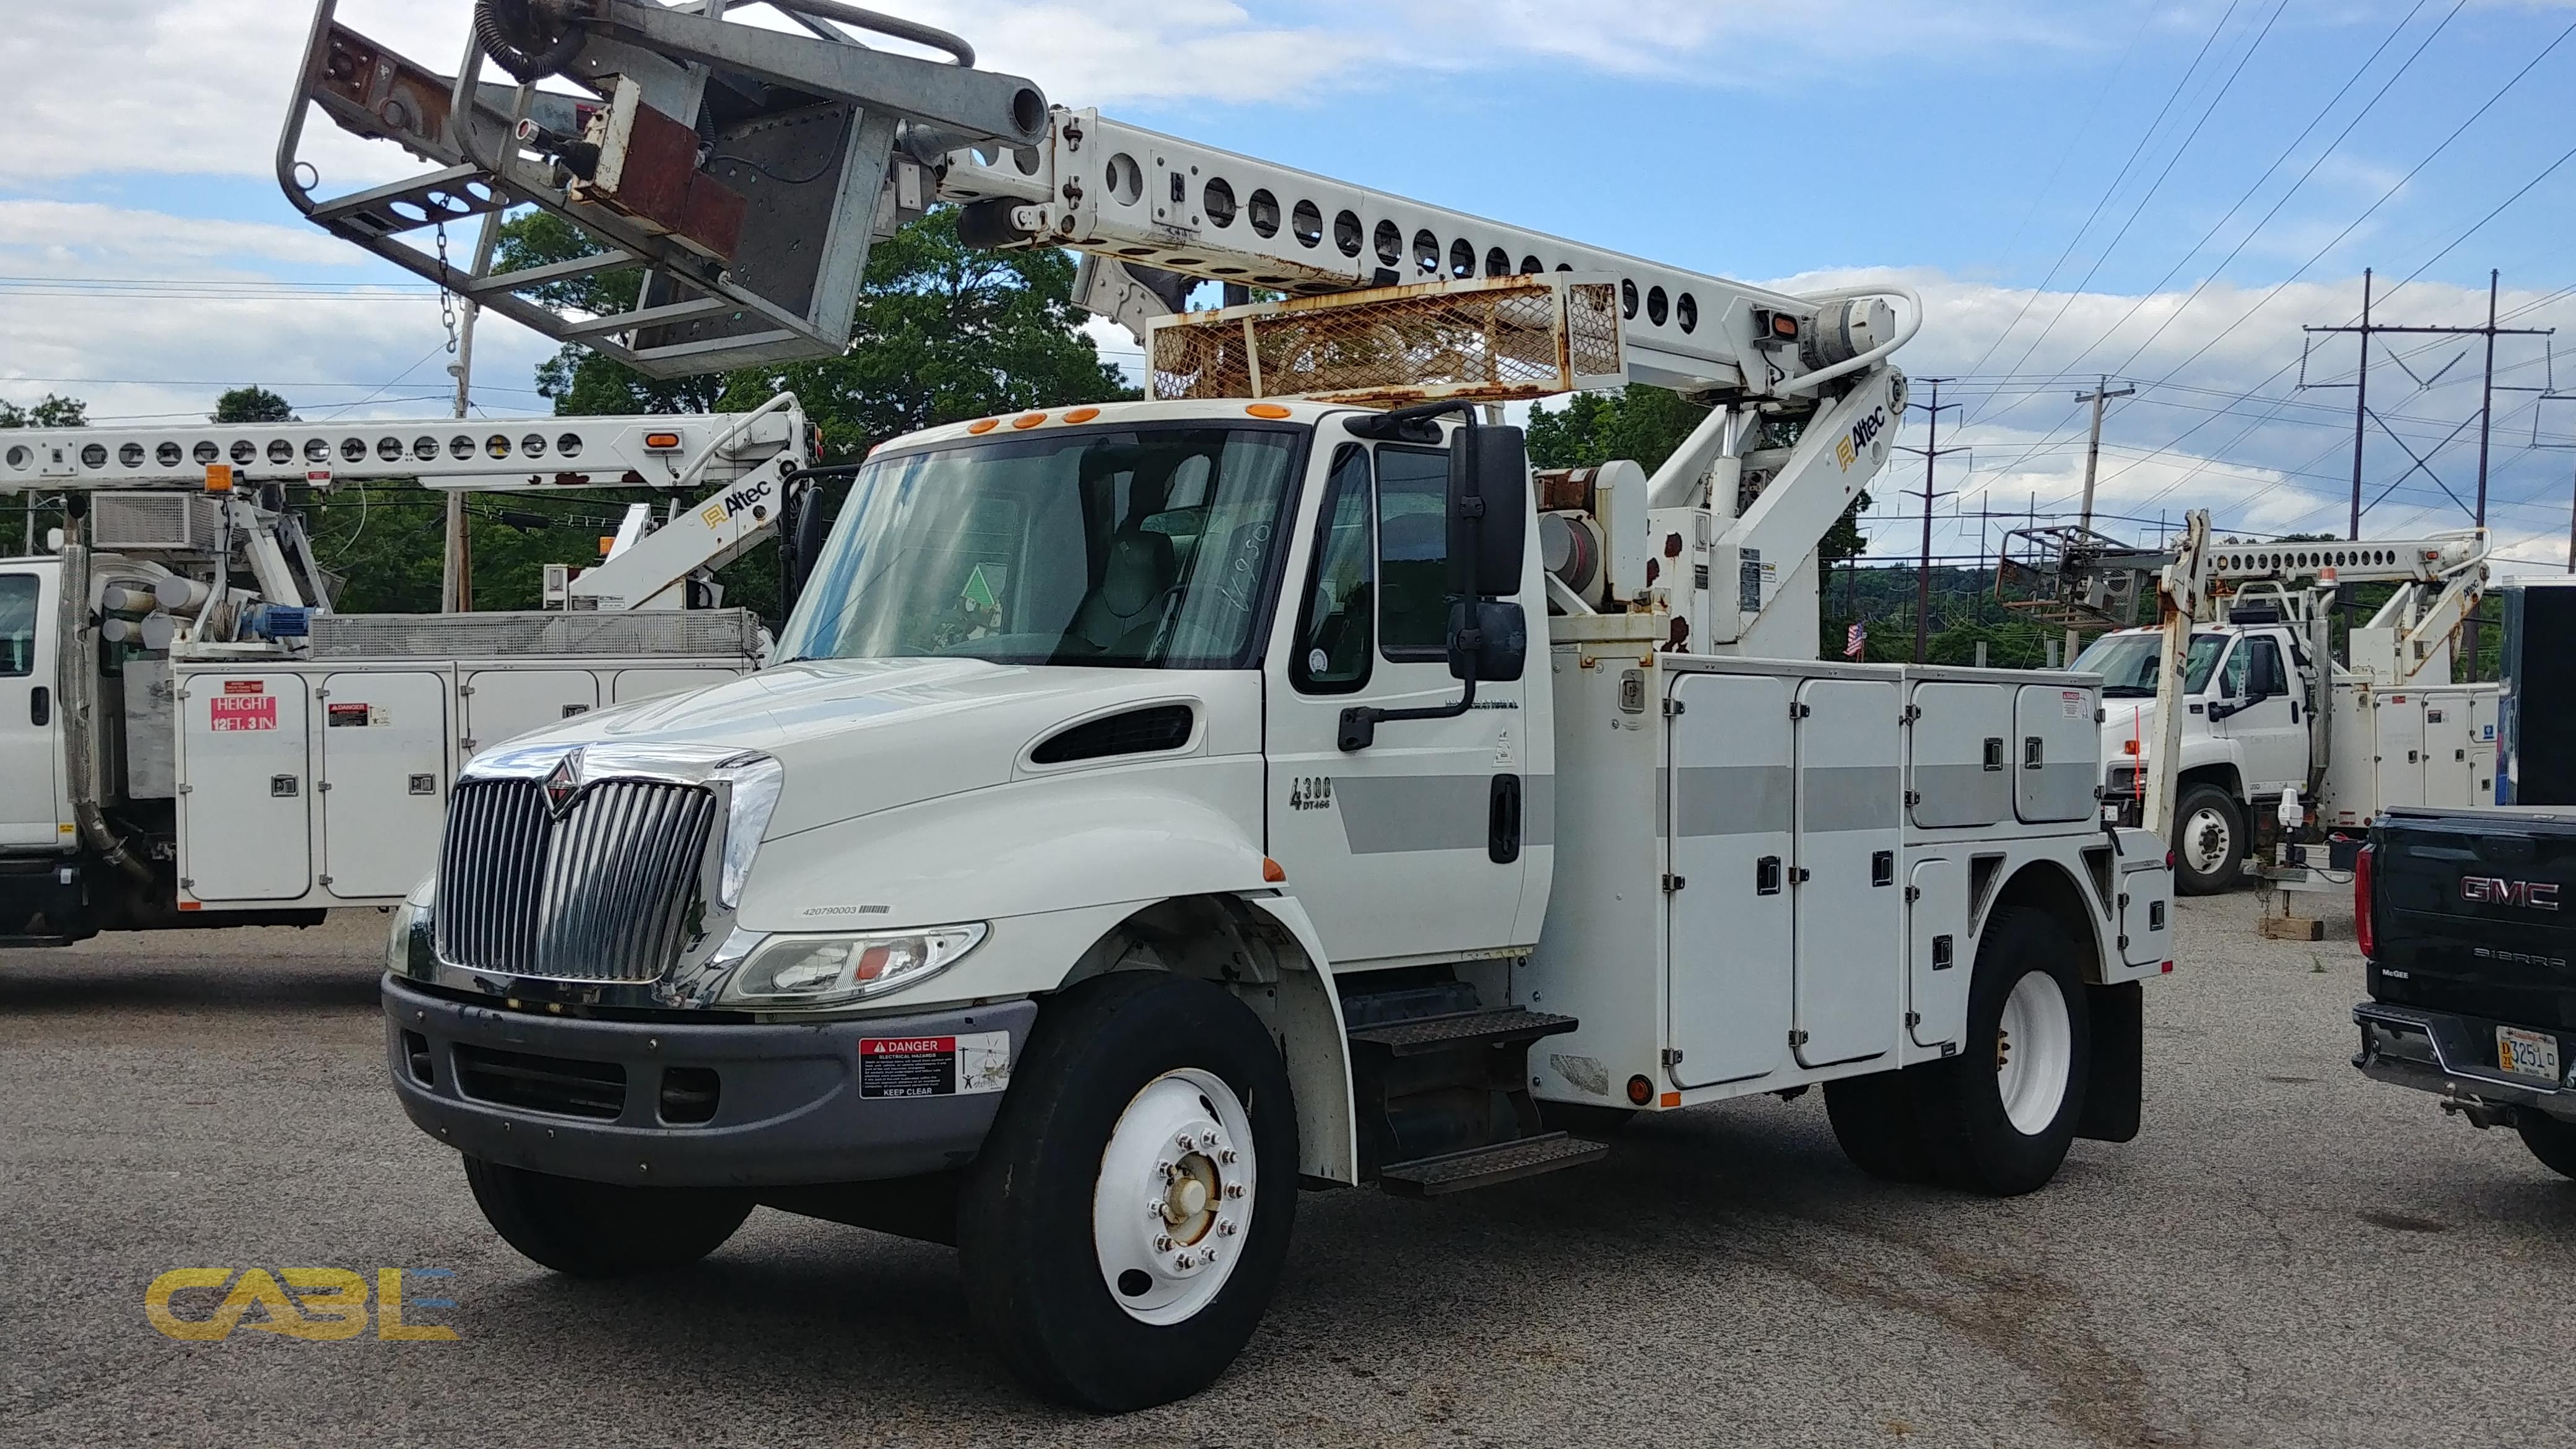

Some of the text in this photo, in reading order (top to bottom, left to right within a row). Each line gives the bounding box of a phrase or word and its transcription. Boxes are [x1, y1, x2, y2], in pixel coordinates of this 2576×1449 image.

[1853, 406, 1885, 457] Altec
[724, 481, 771, 518] Altec
[2463, 579, 2479, 601] Altec
[217, 697, 269, 711] HEIGHT
[248, 716, 257, 729] 3
[259, 716, 276, 729] IN.
[1289, 777, 1331, 811] 4300
[2460, 876, 2559, 912] GMC
[803, 906, 857, 915] 420790003
[2473, 947, 2567, 967] SIERRA
[2382, 968, 2409, 979] McGEE
[889, 1040, 938, 1052] DANGER
[2502, 1042, 2510, 1054] D
[906, 1087, 932, 1095] CLEAR
